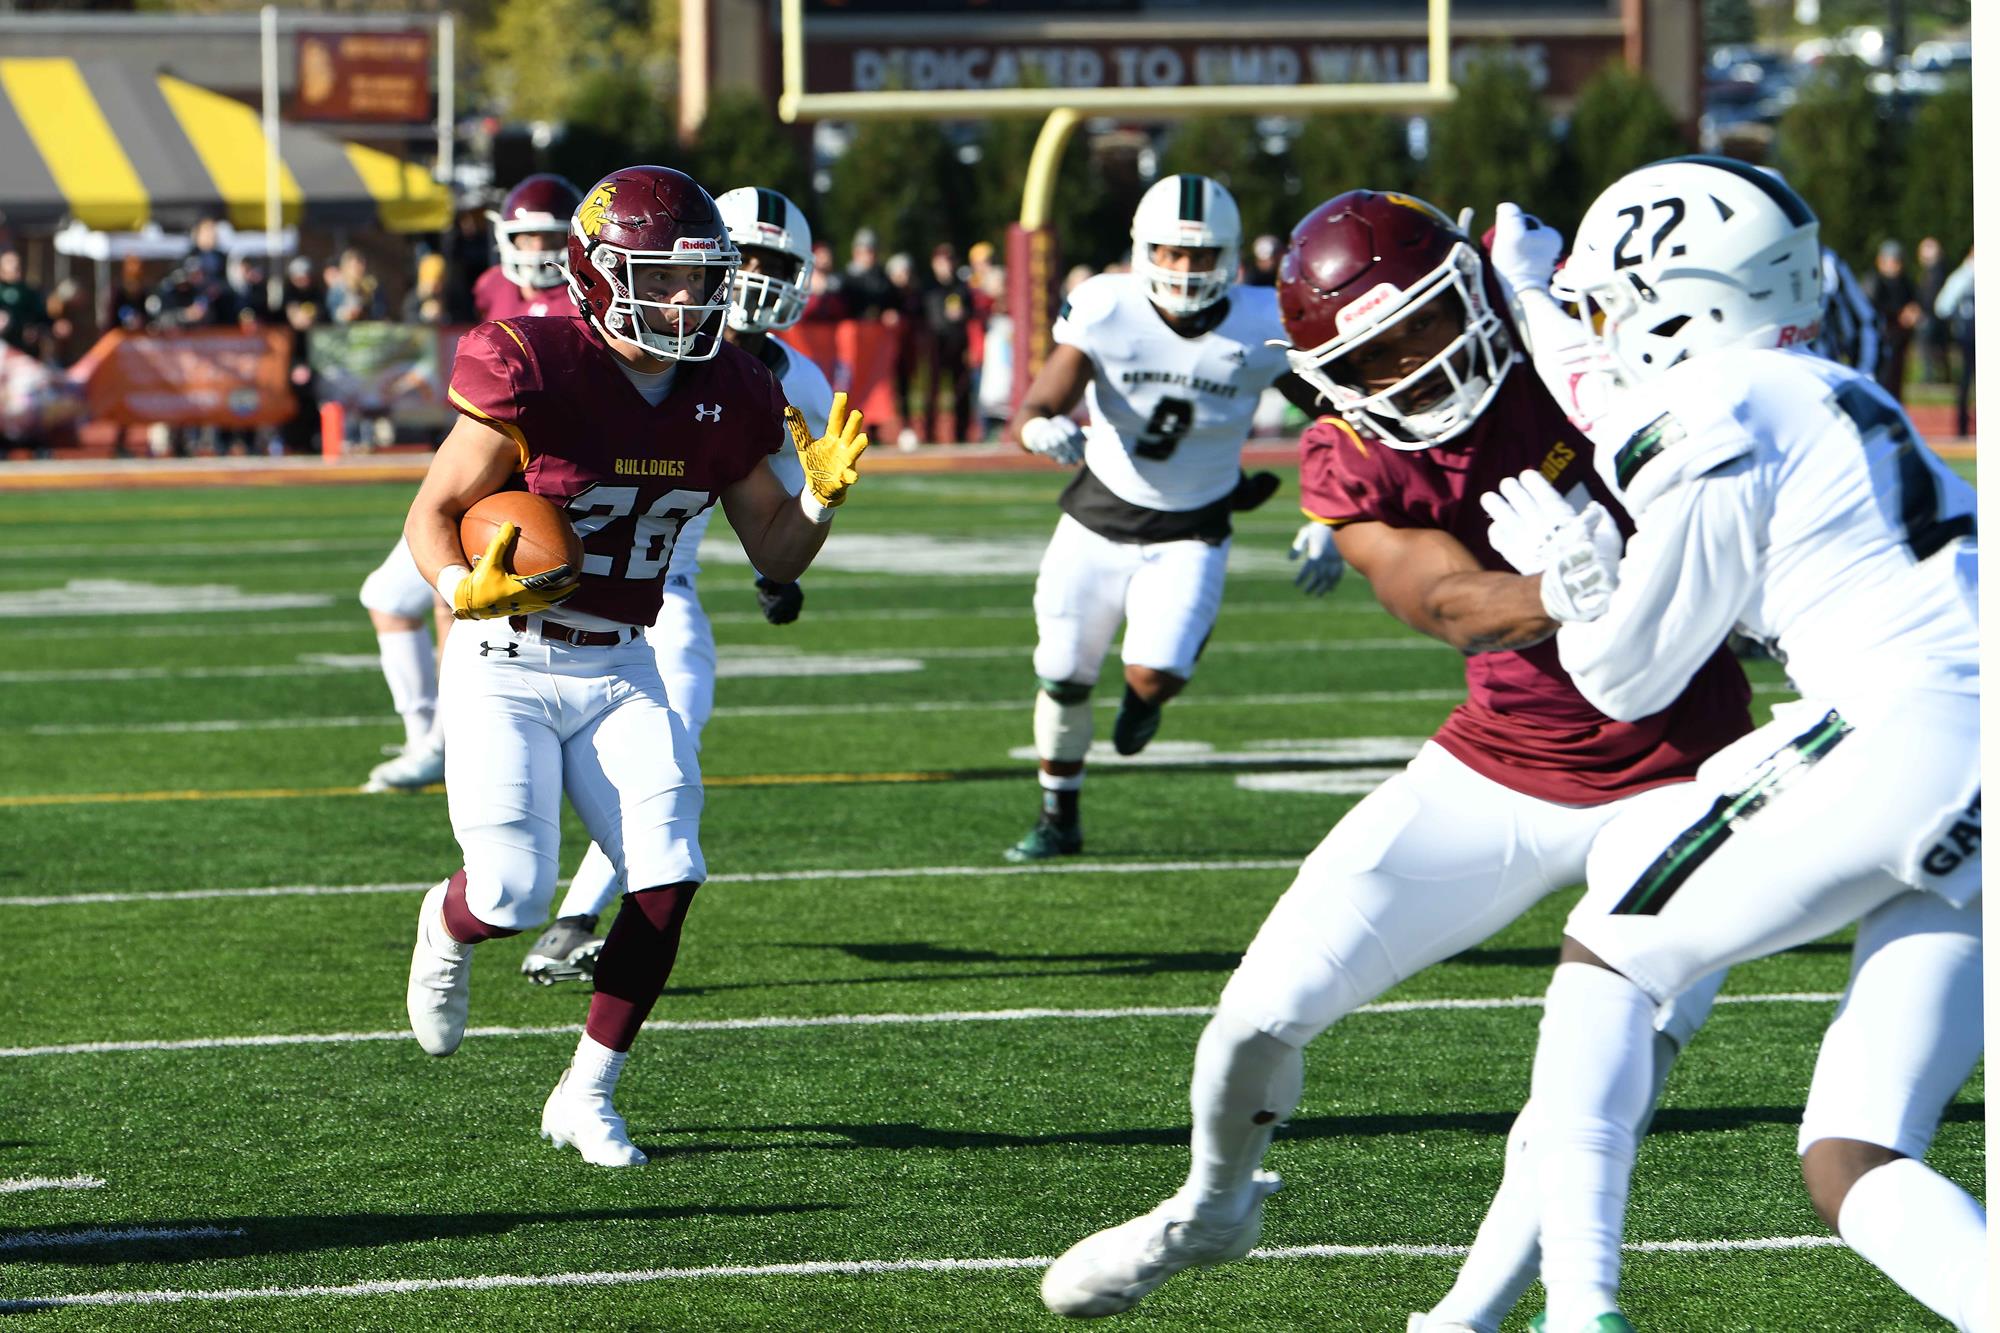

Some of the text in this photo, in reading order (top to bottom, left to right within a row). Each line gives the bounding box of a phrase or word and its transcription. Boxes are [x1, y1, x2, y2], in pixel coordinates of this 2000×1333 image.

[1114, 47, 1185, 88] TO
[682, 241, 716, 250] Riddell
[1614, 197, 1686, 271] 22
[1133, 395, 1194, 463] 9
[614, 458, 685, 477] BULLDOGS
